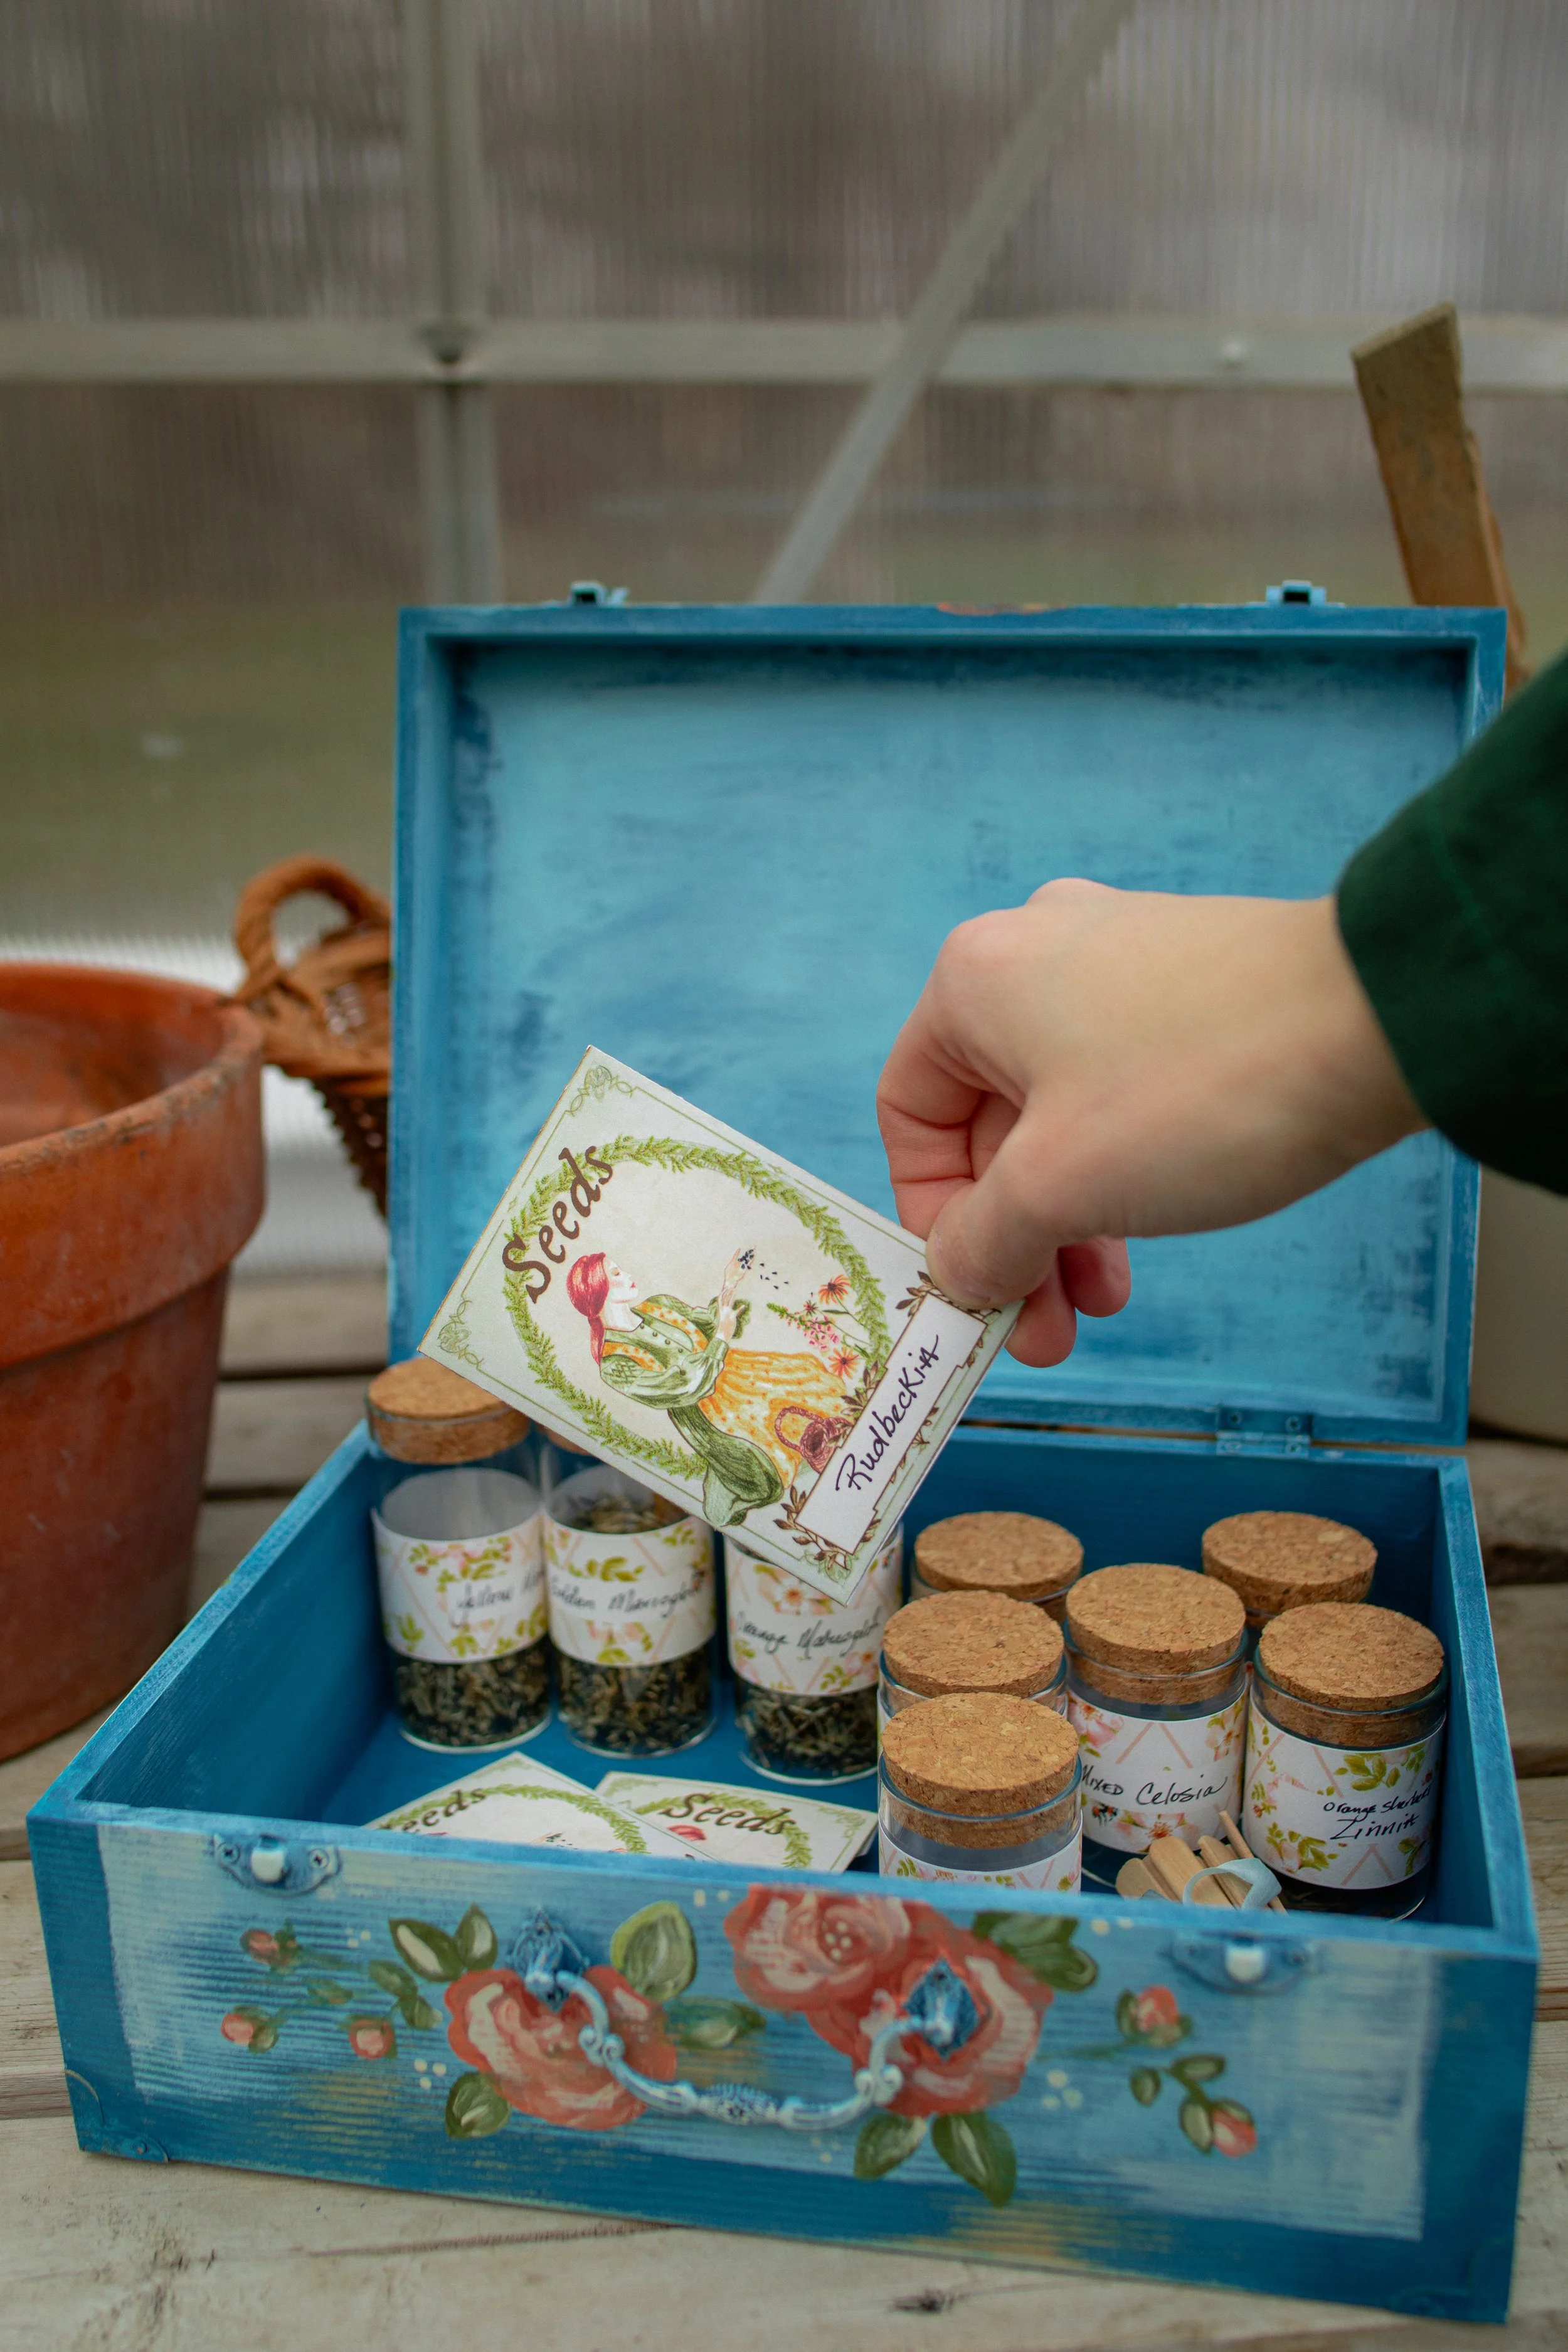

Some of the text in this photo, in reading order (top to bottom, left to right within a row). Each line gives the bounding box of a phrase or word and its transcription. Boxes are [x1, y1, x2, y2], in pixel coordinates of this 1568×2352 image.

[502, 1145, 613, 1304] Seeds
[378, 1788, 487, 1833] eeds
[1135, 1774, 1229, 1805] Celosia
[658, 1793, 797, 1835] Seeds
